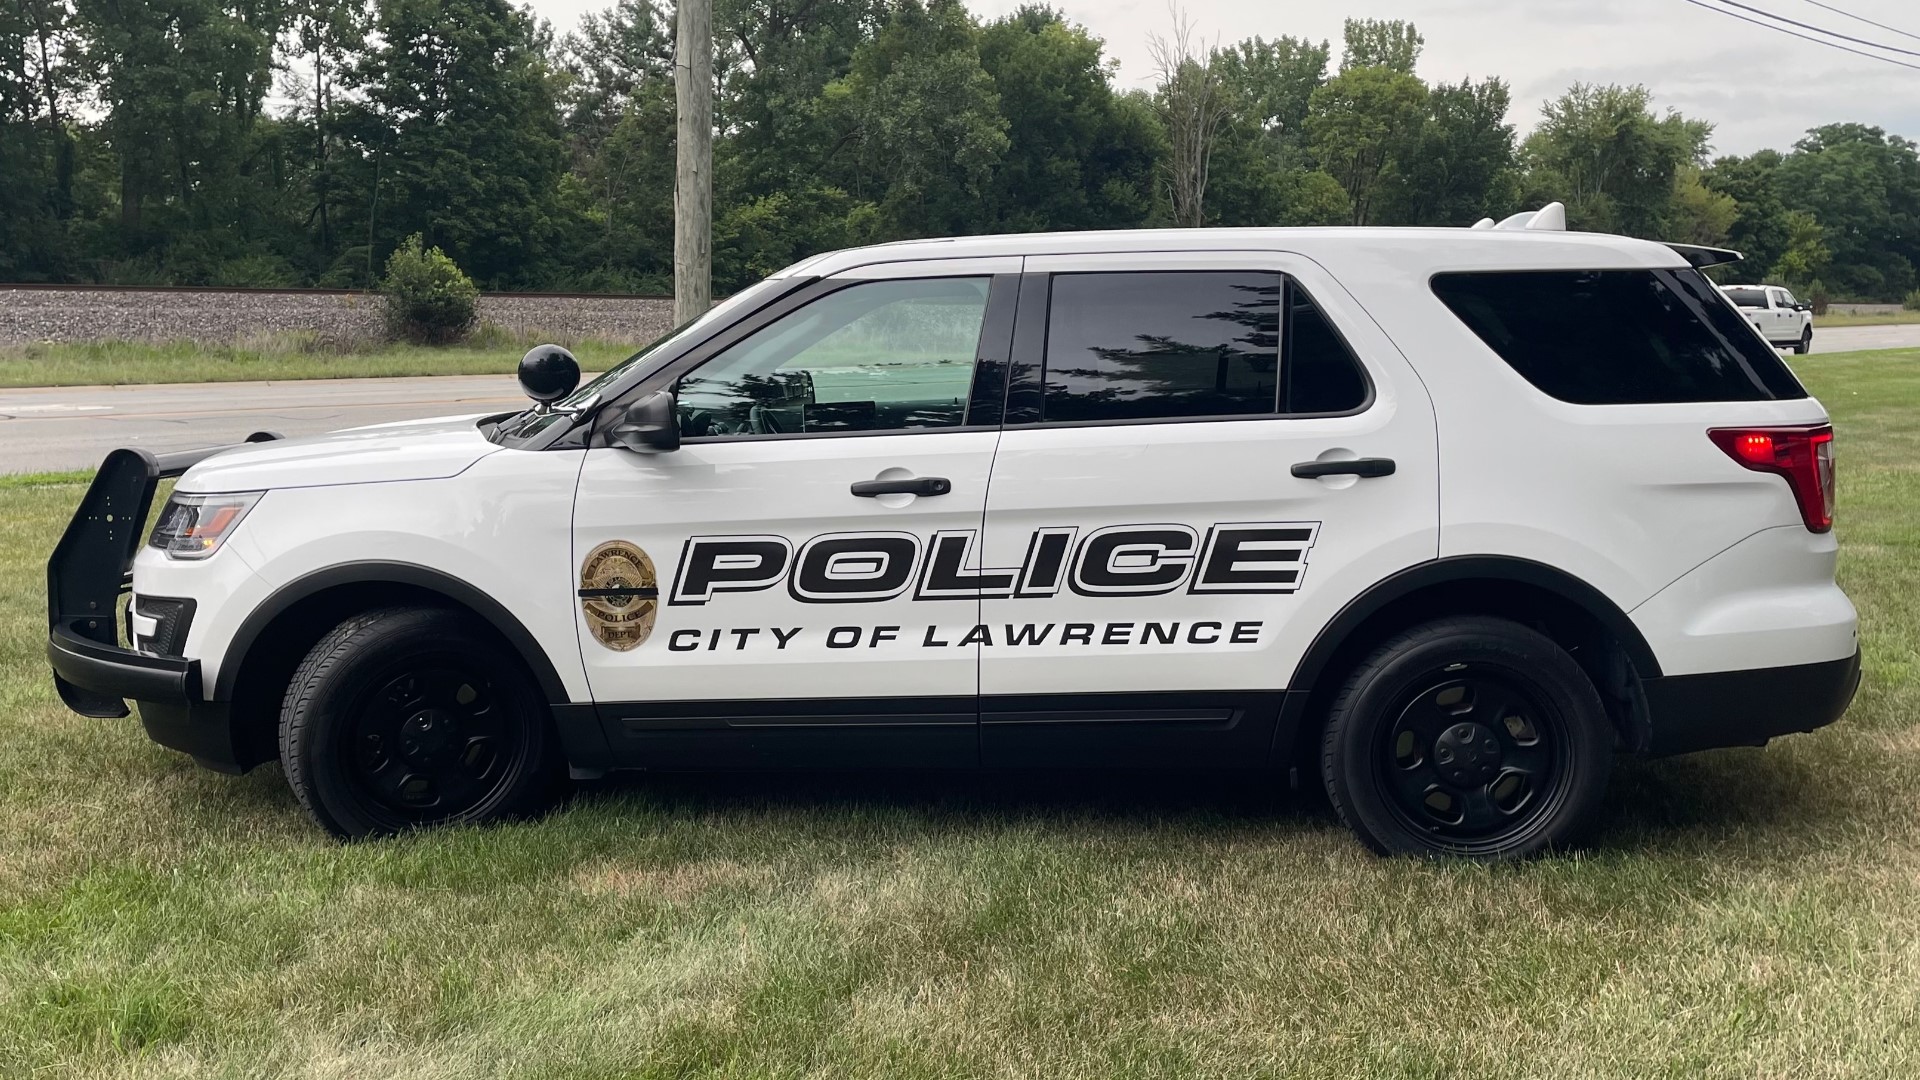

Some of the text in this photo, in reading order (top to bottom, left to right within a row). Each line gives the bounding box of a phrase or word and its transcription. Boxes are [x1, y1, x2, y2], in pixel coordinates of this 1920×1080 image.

[591, 549, 643, 569] LAWRENCE
[668, 521, 1322, 606] POLICE
[596, 610, 642, 623] POLICE
[669, 622, 1264, 652] CITY OF LAWRENCE
